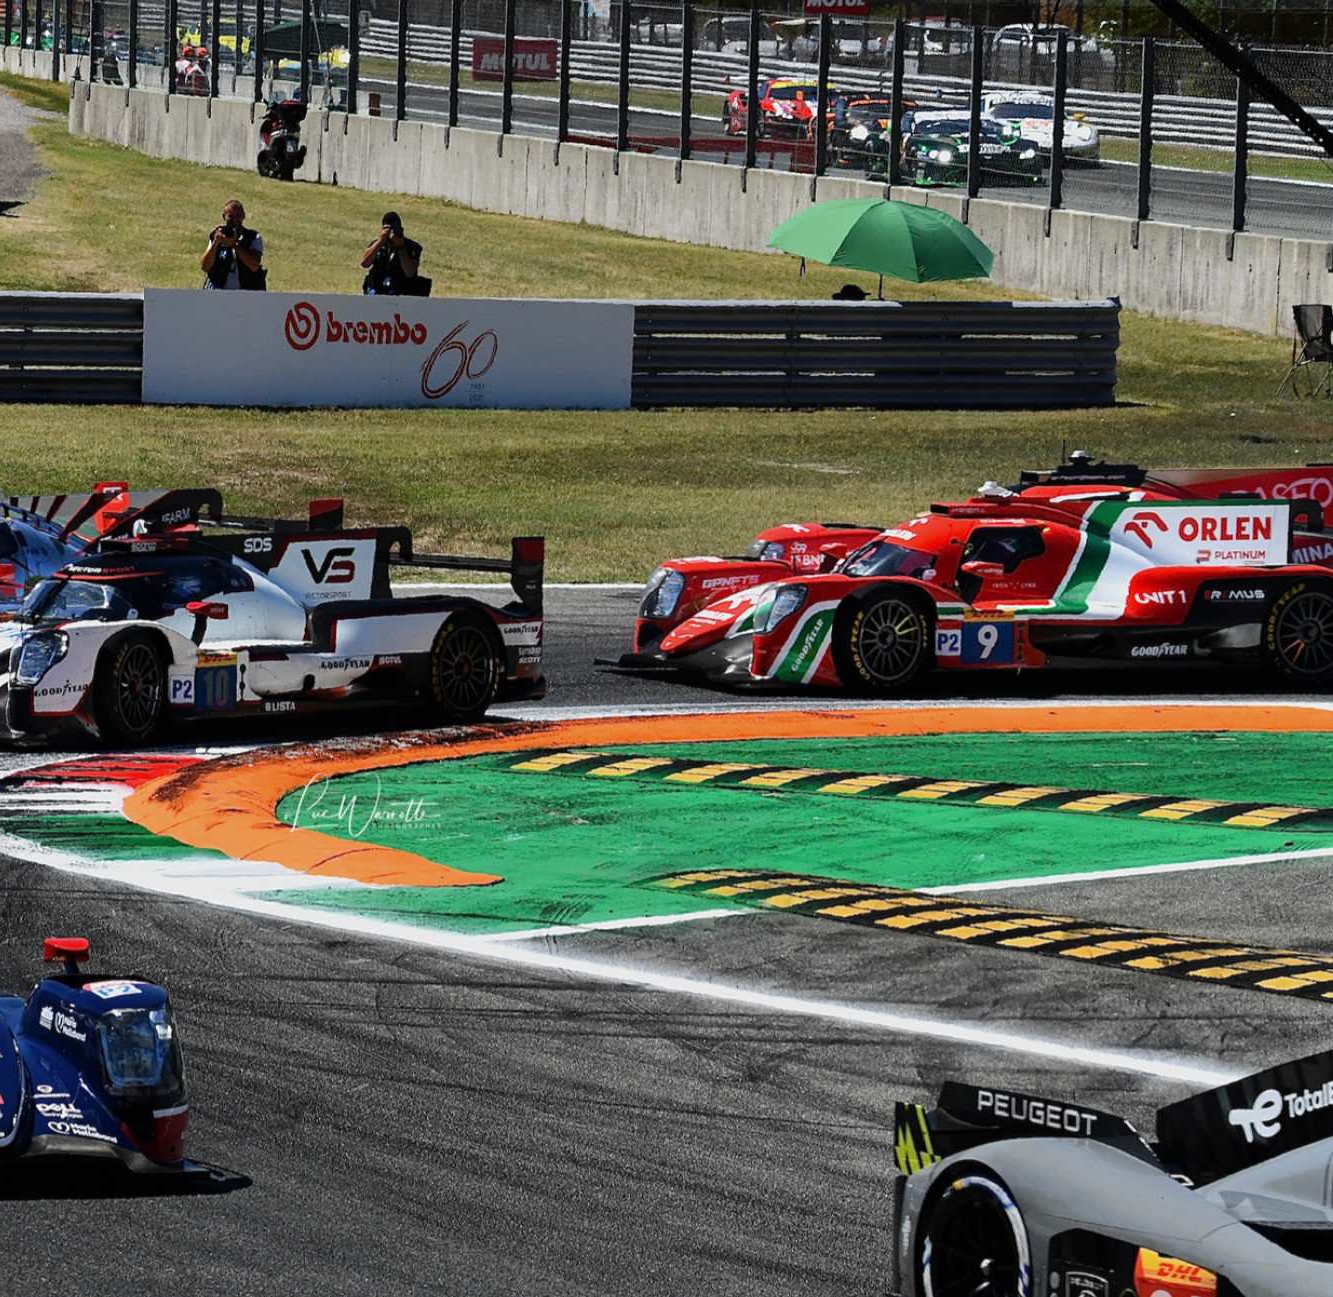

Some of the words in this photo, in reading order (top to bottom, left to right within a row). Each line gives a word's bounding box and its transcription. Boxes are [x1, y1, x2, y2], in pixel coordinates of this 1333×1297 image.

[326, 311, 428, 345] brembo
[1179, 516, 1272, 542] ORLEN
[244, 538, 273, 552] SDS
[1215, 550, 1266, 560] PLATINUM
[791, 618, 824, 672] GOODYEAR
[938, 633, 959, 652] P2
[977, 625, 998, 658] 9
[1131, 642, 1188, 657] GOODYEAR
[172, 680, 192, 699] P2
[202, 669, 230, 700] 10
[36, 1103, 81, 1116] DELL
[977, 1090, 1098, 1135] PEUGEOT
[1157, 1262, 1203, 1283] DHL
